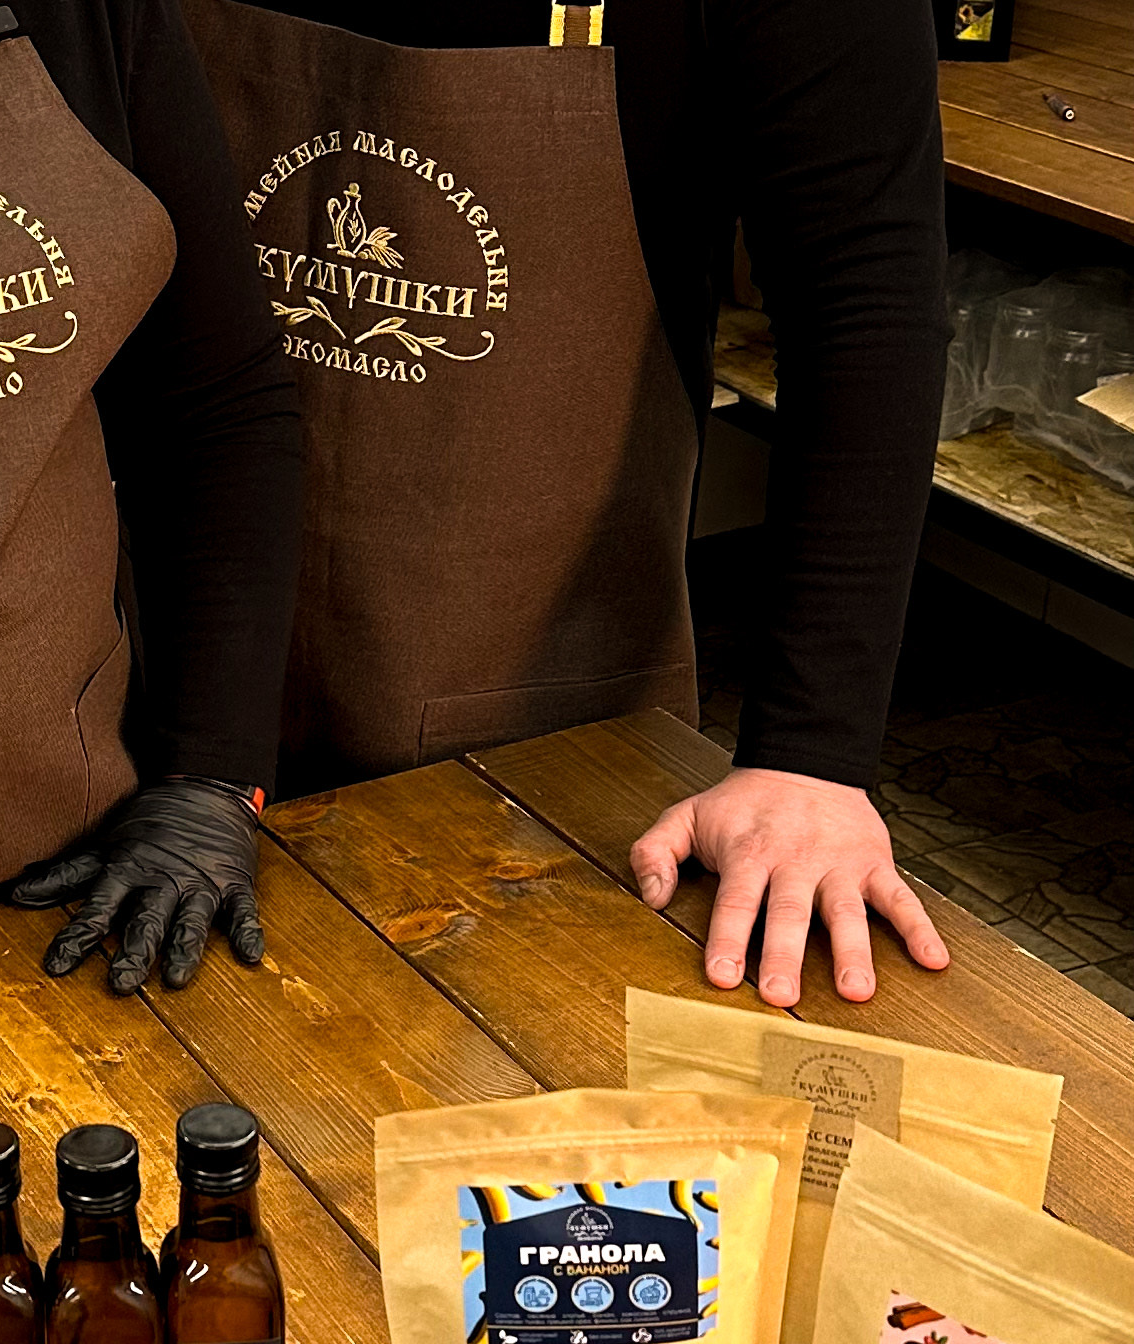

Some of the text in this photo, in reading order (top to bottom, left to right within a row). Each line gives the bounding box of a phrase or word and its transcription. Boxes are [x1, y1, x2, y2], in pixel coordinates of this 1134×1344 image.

[243, 130, 509, 312] МЕЙНАЯ МАСЛОДЕЛЬНЯ
[253, 243, 478, 318] КУМУШКИ
[825, 1132, 853, 1149] СЕМ
[519, 1243, 666, 1266] ГРАНОЛА
[553, 1263, 630, 1276] С БАНАНОМ
